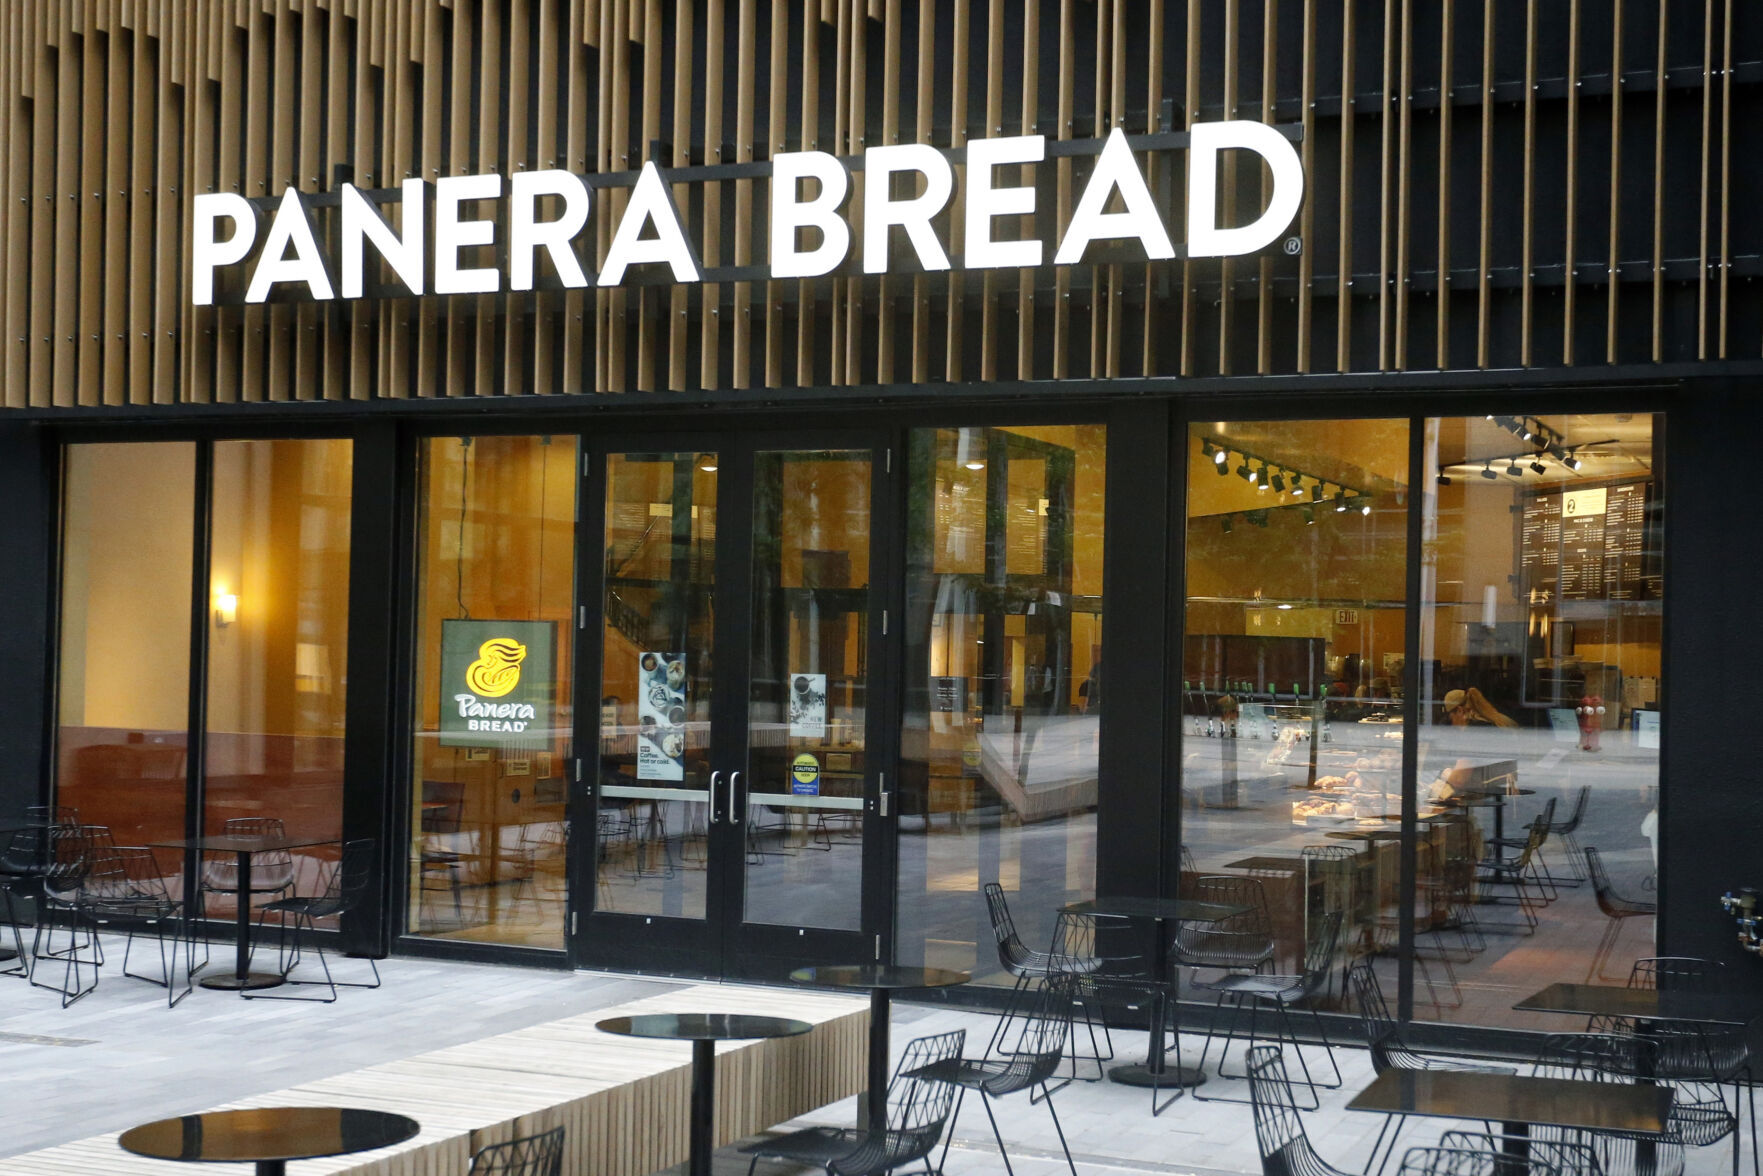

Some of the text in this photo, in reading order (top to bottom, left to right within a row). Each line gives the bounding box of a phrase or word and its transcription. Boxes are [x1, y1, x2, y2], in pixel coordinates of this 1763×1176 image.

[192, 119, 1304, 306] PANERA BREAD
[1339, 610, 1356, 623] EXIT
[454, 694, 535, 719] Panera
[468, 720, 525, 733] BREAD
